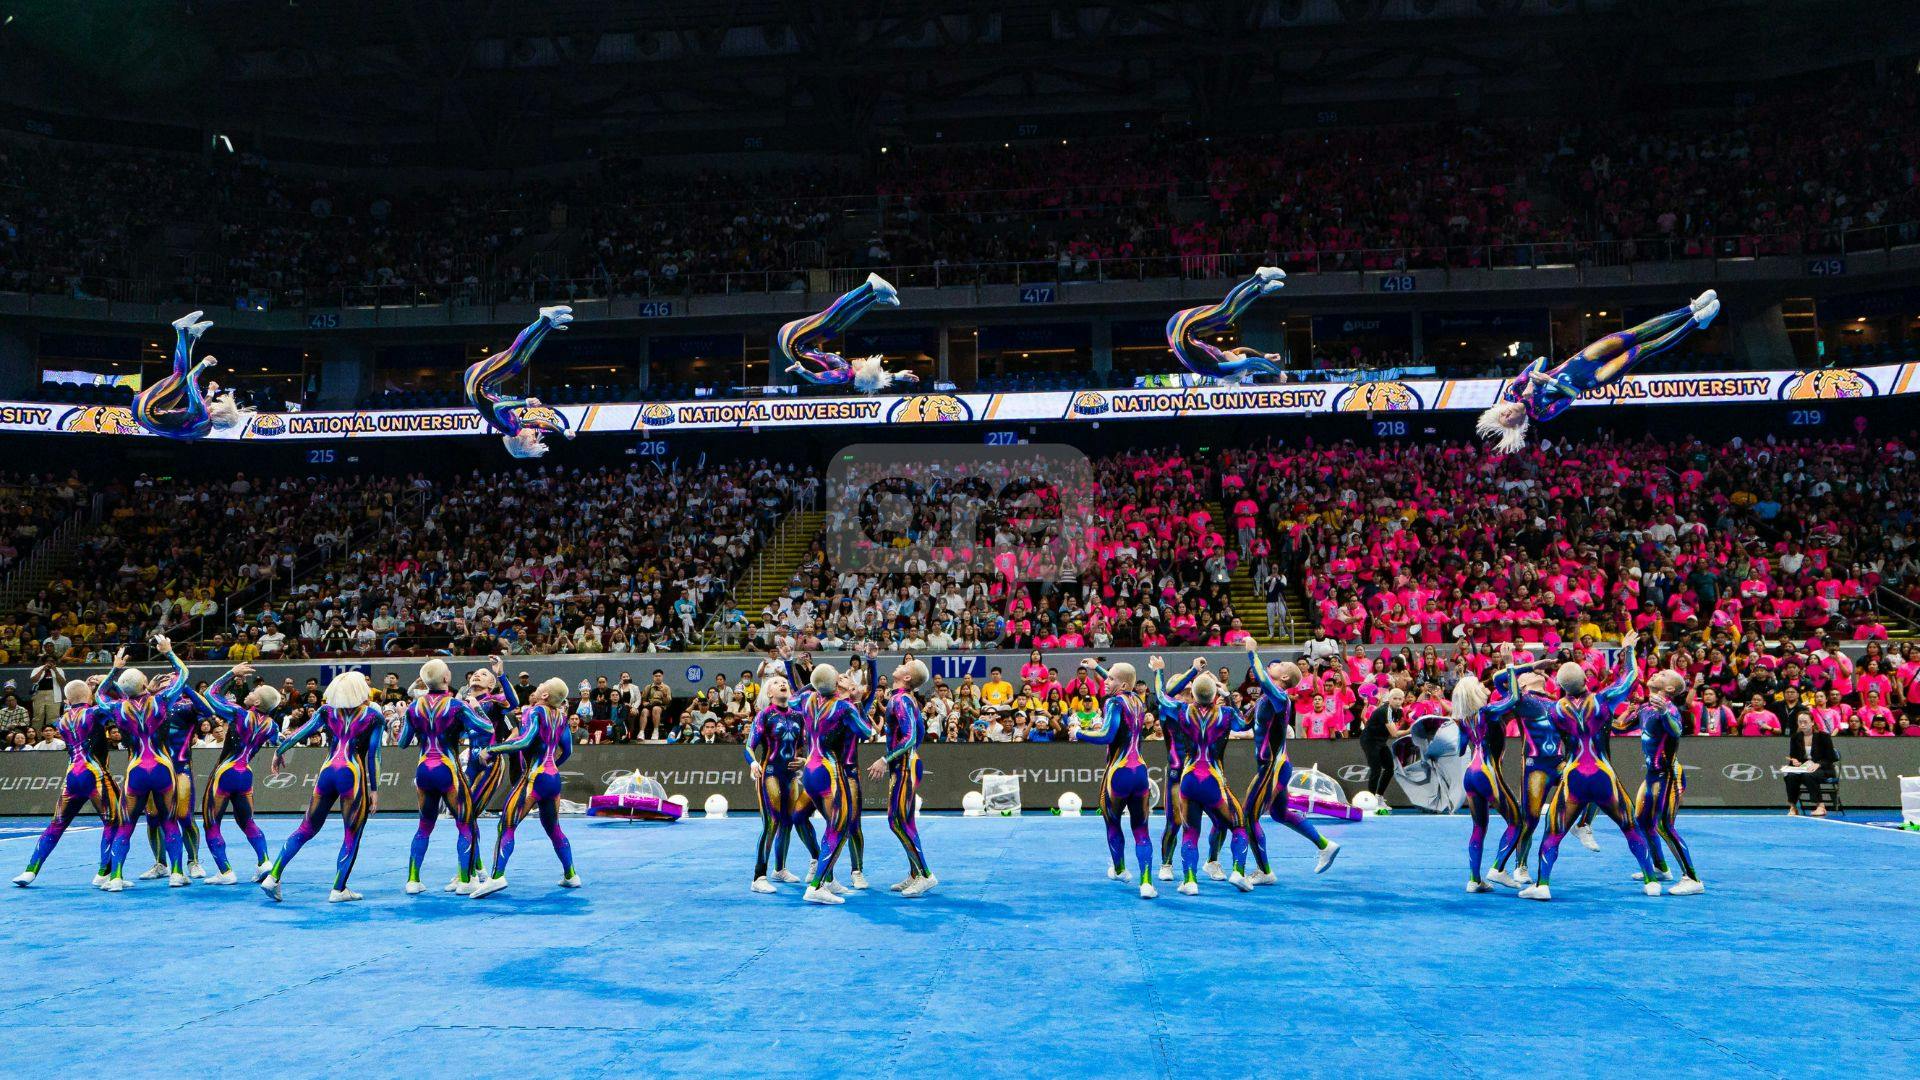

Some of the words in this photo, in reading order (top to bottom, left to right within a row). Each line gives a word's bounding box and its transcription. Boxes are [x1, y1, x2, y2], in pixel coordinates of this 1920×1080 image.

[1811, 259, 1842, 275] 419
[1383, 276, 1413, 291] 418
[1023, 288, 1050, 303] 417
[642, 302, 669, 317] 416
[312, 313, 336, 328] 415
[1649, 377, 1770, 397] UNIVERSITY
[1113, 393, 1210, 412] NATIONAL
[1211, 390, 1326, 410] UNIVERSITY
[0, 406, 52, 425] SITY
[679, 404, 770, 423] NATIONAL
[771, 401, 881, 420] UNIVERSITY
[1792, 410, 1821, 425] 219
[289, 415, 377, 434] NATIONAL
[378, 413, 482, 432] UNIVERSITY
[1377, 420, 1406, 436] 218
[988, 431, 1014, 446] 217
[640, 441, 666, 455] 216
[310, 449, 334, 463] 215
[941, 656, 977, 678] 117
[643, 770, 743, 785] HYUNDAI
[1013, 768, 1104, 783] HYUNDA
